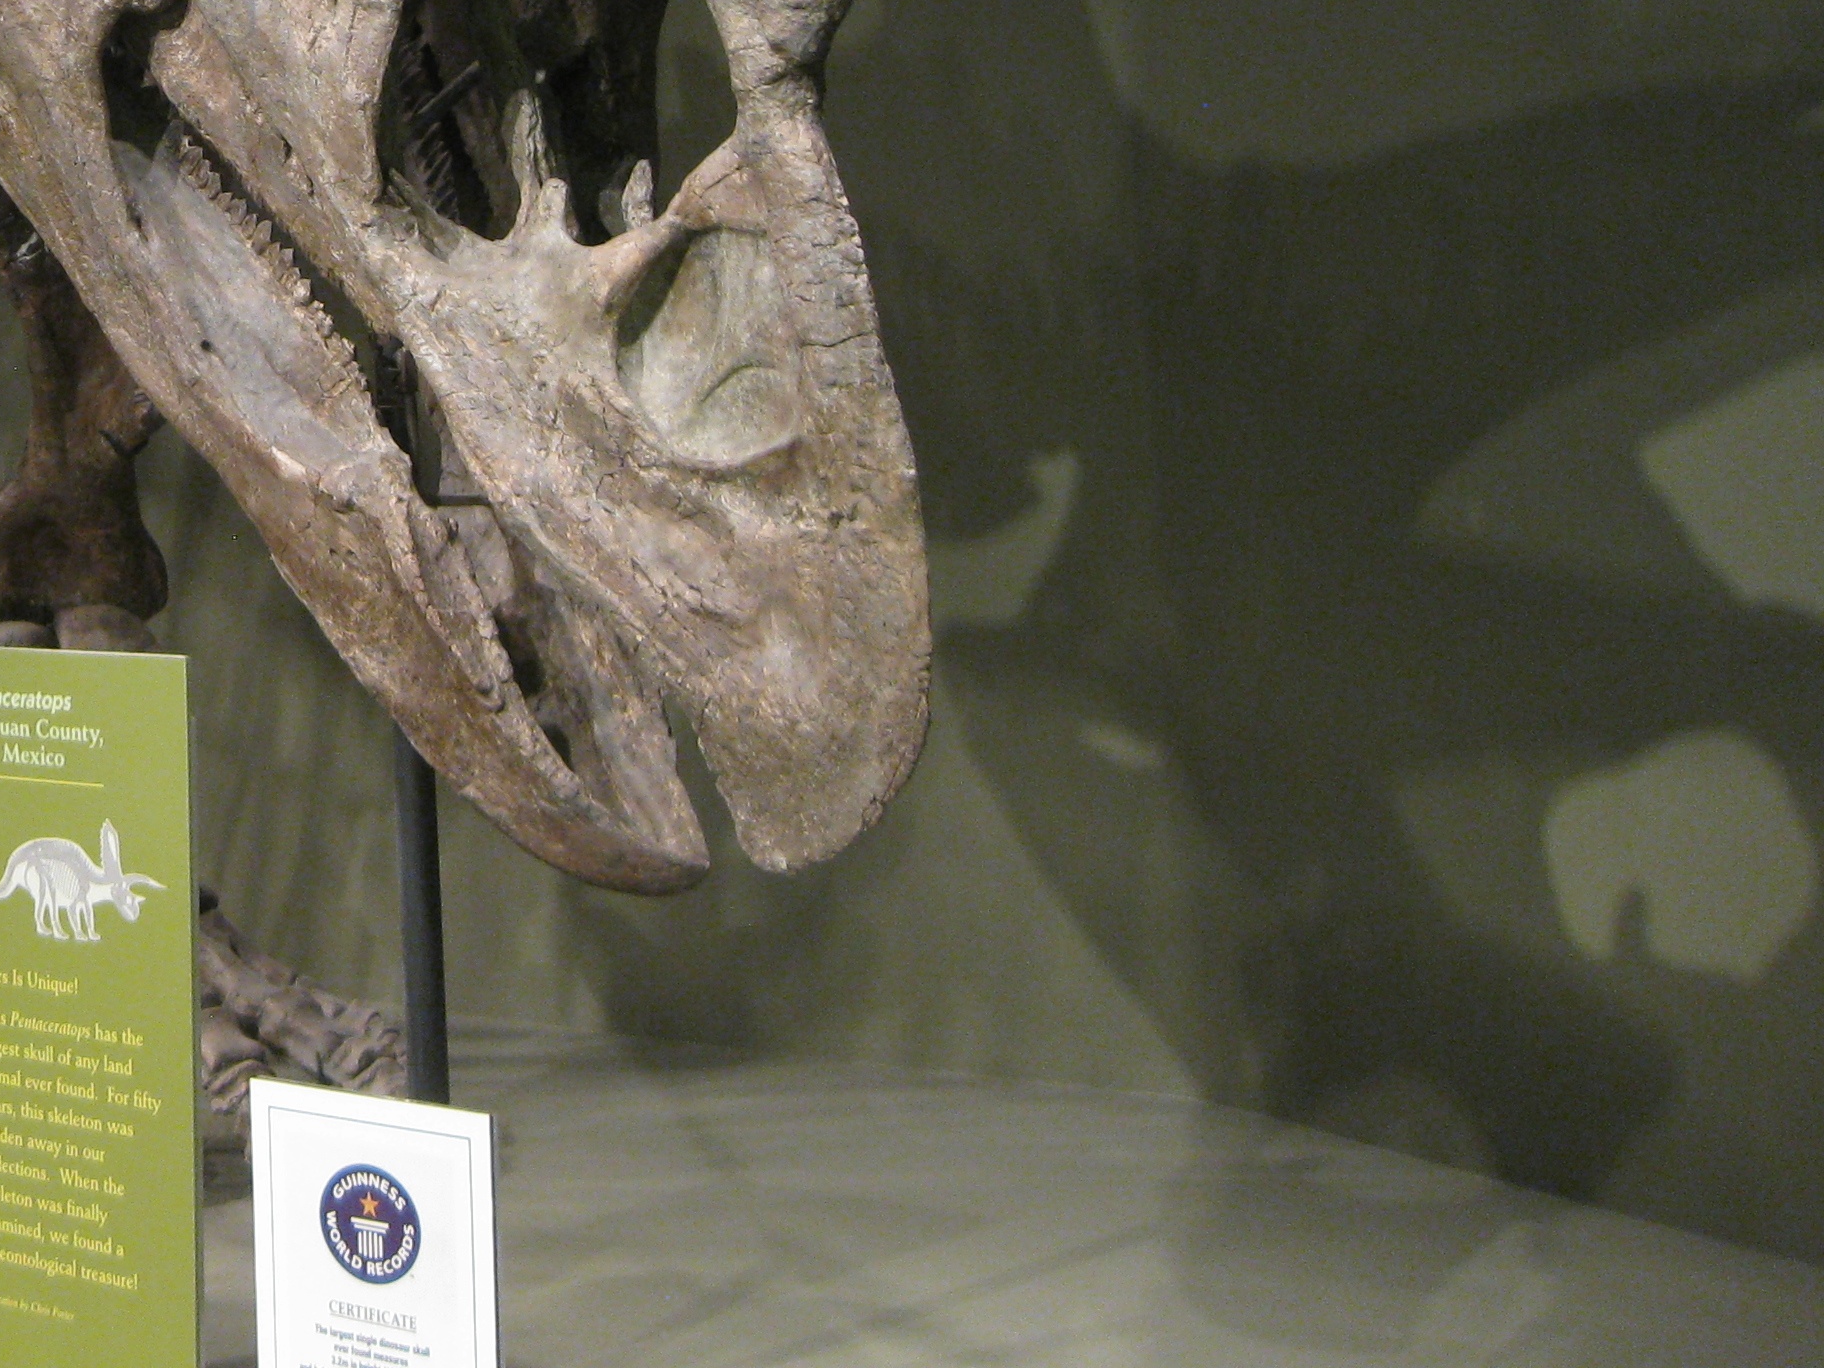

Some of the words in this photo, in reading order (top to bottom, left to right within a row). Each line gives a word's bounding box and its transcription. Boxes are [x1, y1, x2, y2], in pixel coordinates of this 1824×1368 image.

[36, 718, 105, 748] County,
[3, 743, 65, 767] Mexico
[12, 969, 23, 986] Is
[26, 970, 79, 997] Unique!
[9, 1010, 91, 1042] Pentaceratops
[95, 1023, 118, 1043] has
[121, 1027, 144, 1047] the
[23, 1042, 54, 1063] skull
[58, 1048, 73, 1066] of
[75, 1054, 100, 1075] any
[104, 1054, 133, 1076] land
[25, 1077, 53, 1093] ever
[56, 1077, 98, 1100] found.
[107, 1085, 130, 1106] For
[133, 1090, 162, 1116] fifty
[21, 1101, 44, 1120] this
[48, 1106, 103, 1132] skeleton
[107, 1122, 135, 1137] was
[27, 1137, 62, 1158] away
[66, 1138, 78, 1158] in
[82, 1146, 106, 1162] our
[59, 1167, 99, 1192] When
[103, 1176, 125, 1196] the
[332, 1171, 406, 1211] GUINNESS
[36, 1198, 63, 1214] was
[66, 1200, 109, 1228] finally
[49, 1229, 69, 1245] we
[73, 1230, 112, 1254] found
[116, 1243, 125, 1258] a
[325, 1209, 363, 1270] WORLD
[366, 1223, 415, 1277] RECORDS
[80, 1264, 139, 1290] treasure!
[329, 1299, 417, 1330] CERTIFICATE
[330, 1326, 354, 1341] largest
